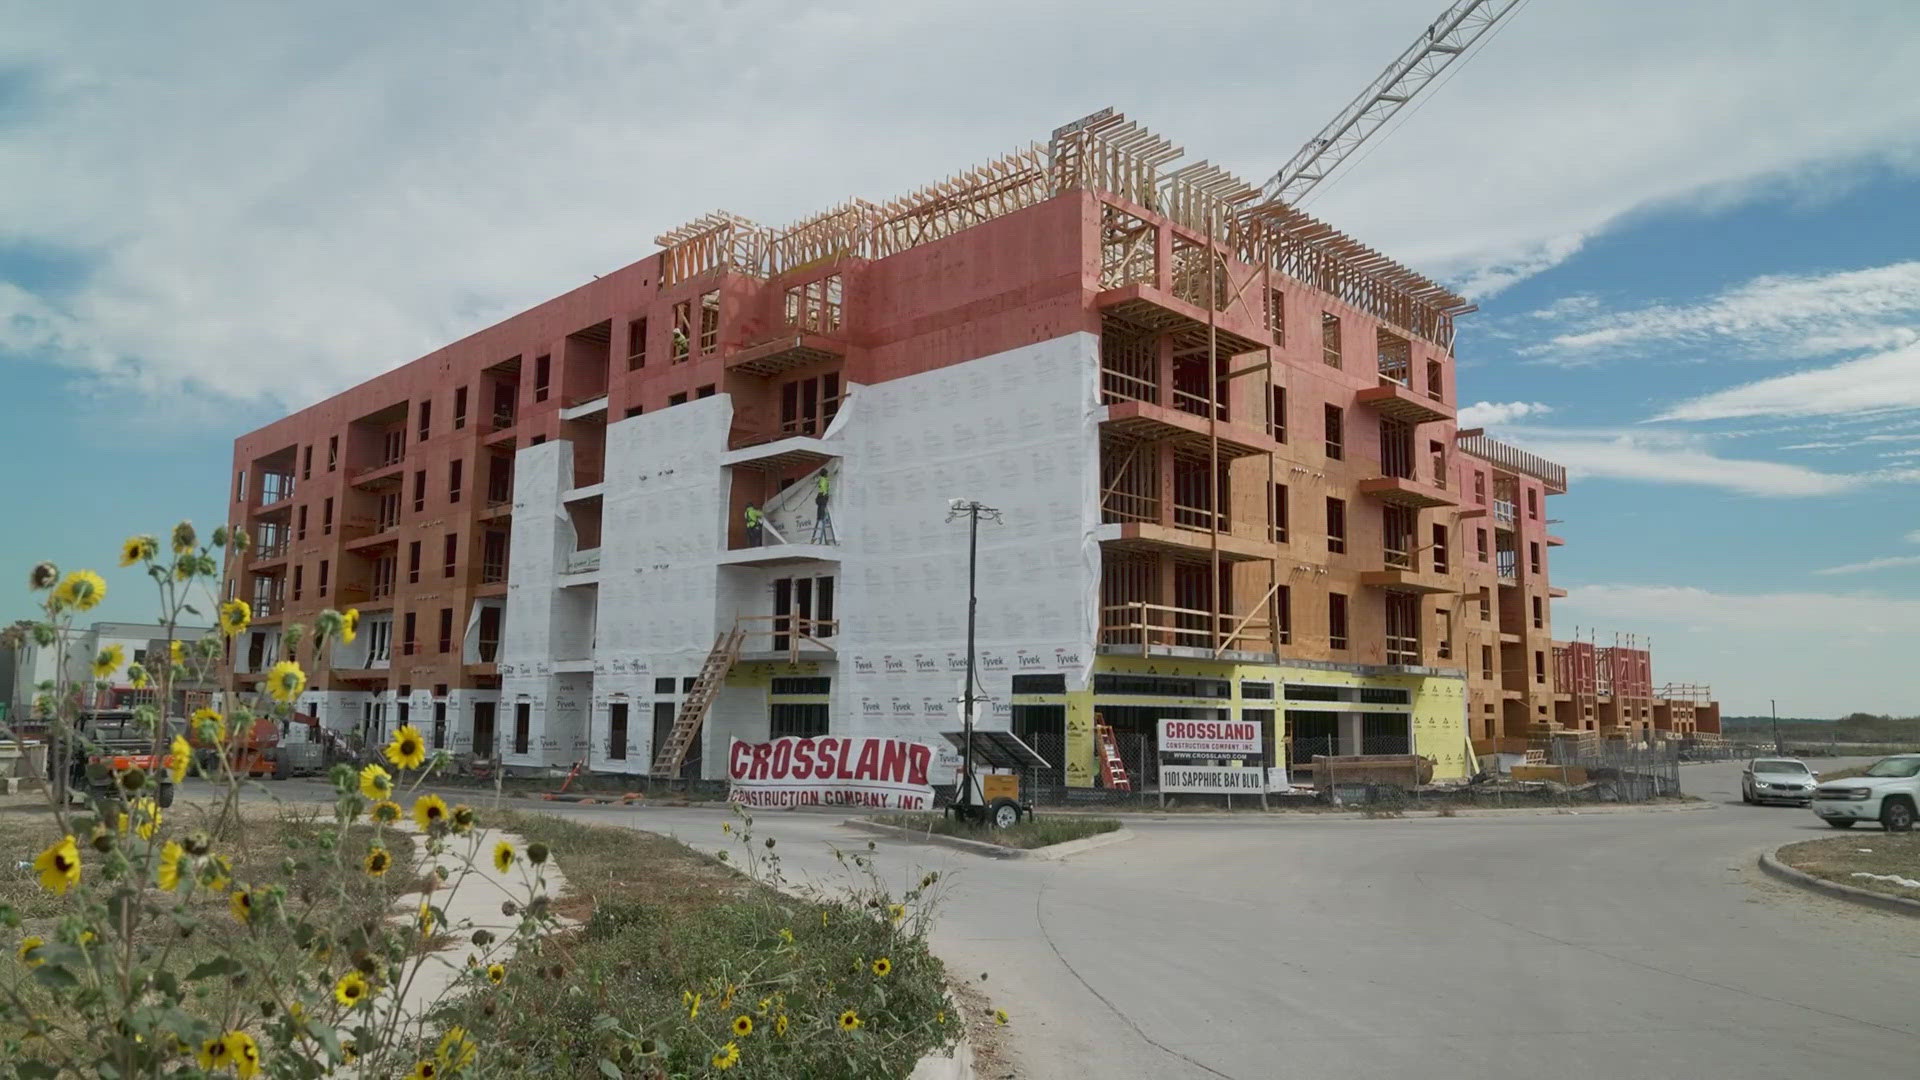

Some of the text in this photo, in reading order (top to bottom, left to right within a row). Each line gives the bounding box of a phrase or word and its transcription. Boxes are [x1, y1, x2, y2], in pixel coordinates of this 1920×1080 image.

[915, 658, 935, 668] Tyvek
[982, 656, 1003, 666] Tyvek
[1018, 655, 1041, 665] Tyvek
[1056, 653, 1079, 663] Tyvek
[855, 661, 873, 669] Tyvek
[885, 660, 903, 669] Tyvek
[862, 702, 880, 711] Tyvek
[892, 702, 911, 711] Tyvek
[924, 702, 943, 712] Tyvek
[1166, 722, 1255, 740] CROSSLAND
[1174, 752, 1247, 760] WWW.CROSSLAND.COM
[731, 738, 931, 786] CROSSLAND
[1164, 771, 1180, 787] 1101
[1182, 771, 1222, 787] SAPPHIRE
[1224, 772, 1240, 788] BAY
[1242, 773, 1262, 789] BLVD.
[731, 790, 819, 806] CONSTRUCTION
